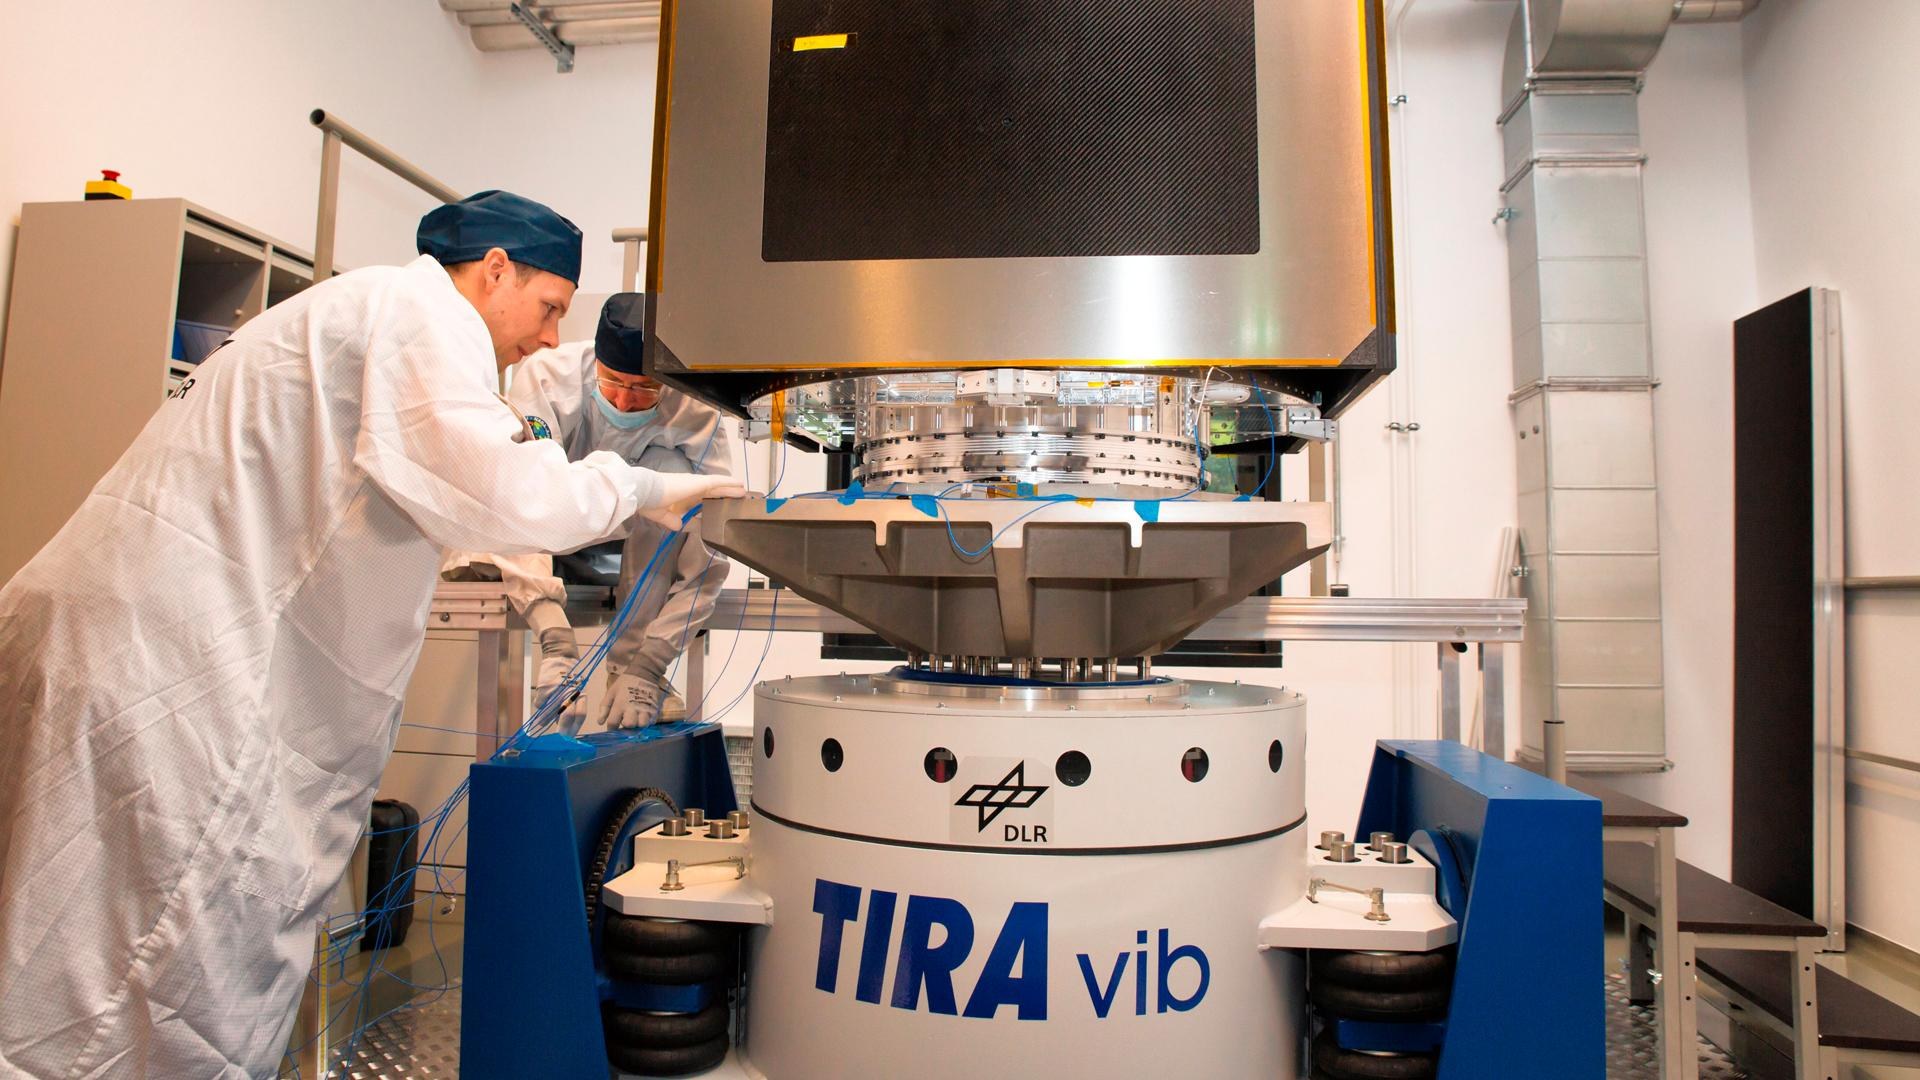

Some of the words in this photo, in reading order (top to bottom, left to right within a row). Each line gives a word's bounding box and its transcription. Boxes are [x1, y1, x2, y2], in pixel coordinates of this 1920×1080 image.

[1004, 824, 1048, 843] DLR
[813, 878, 1049, 1021] TIRA
[1076, 928, 1210, 1018] vib
